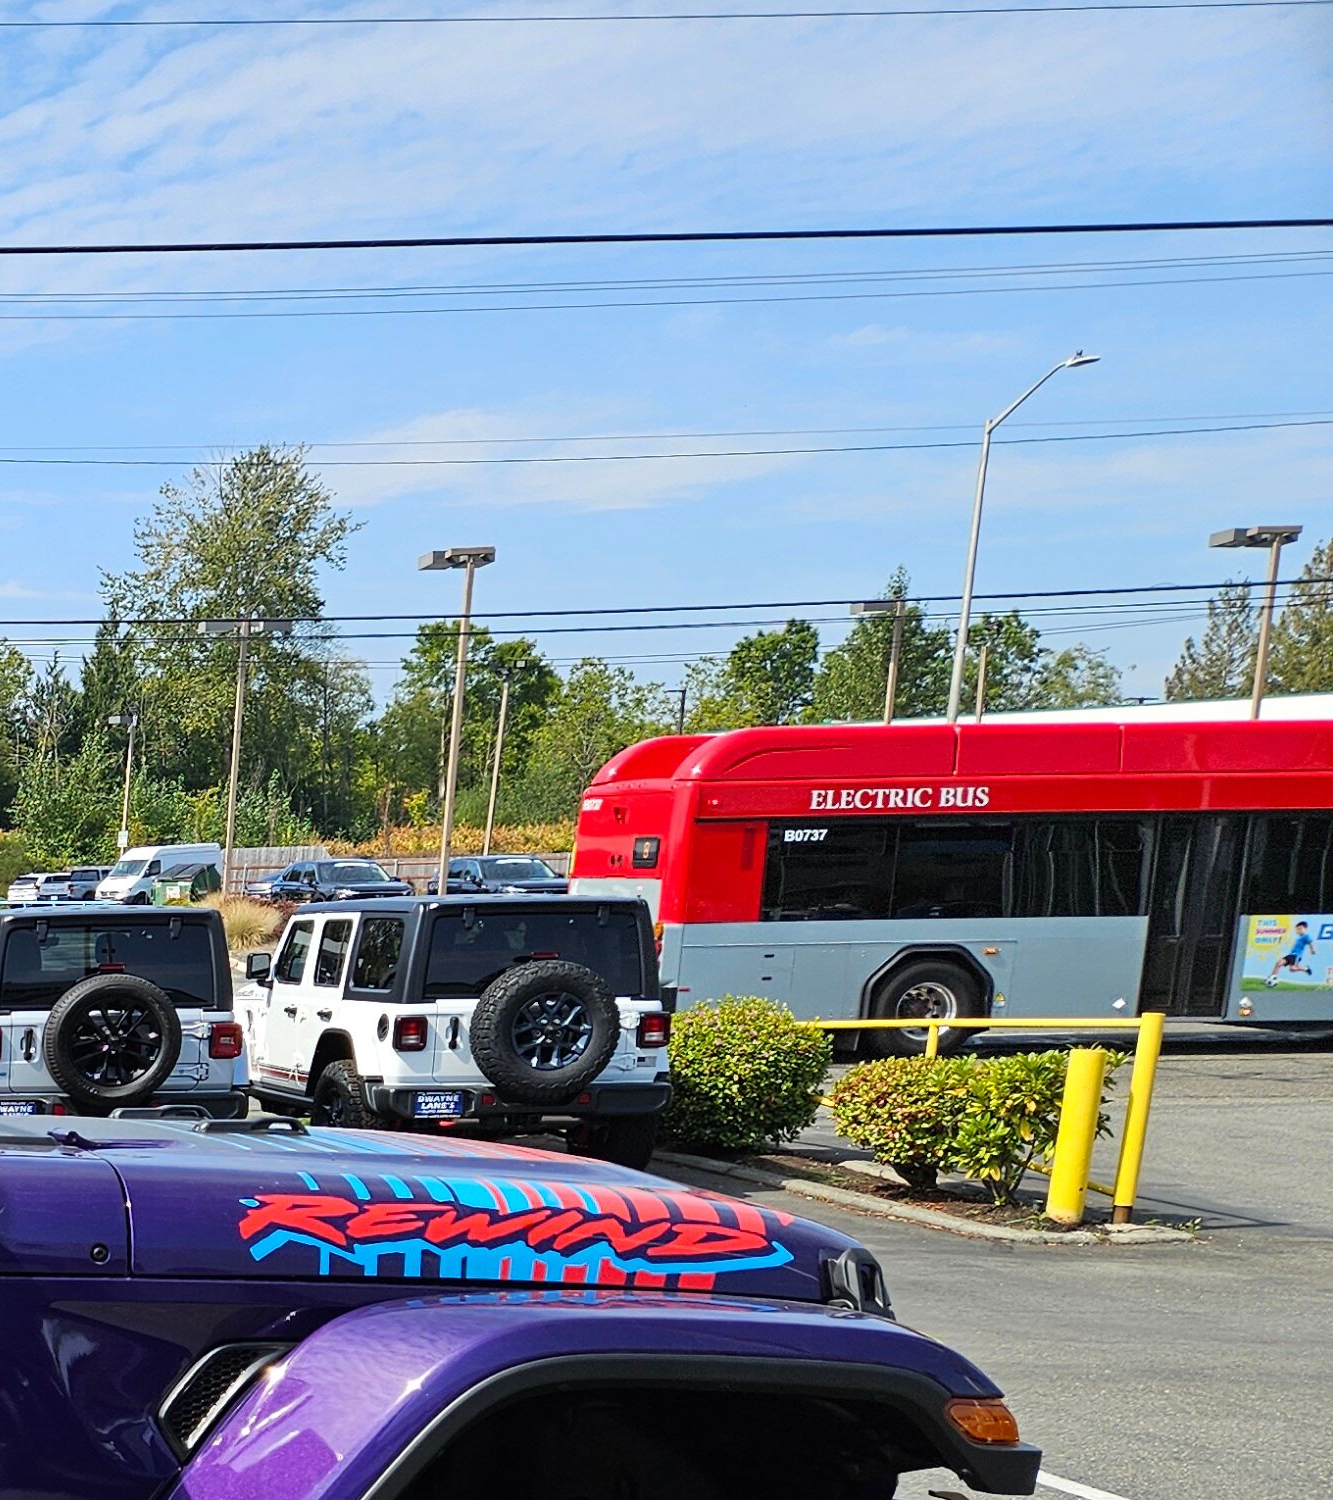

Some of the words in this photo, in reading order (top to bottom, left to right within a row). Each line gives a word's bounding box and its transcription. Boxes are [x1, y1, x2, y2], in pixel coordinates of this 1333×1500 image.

[809, 787, 933, 809] ELECTRIC
[938, 786, 989, 807] BUS
[784, 829, 828, 842] B0737
[238, 1193, 768, 1256] REWIND
